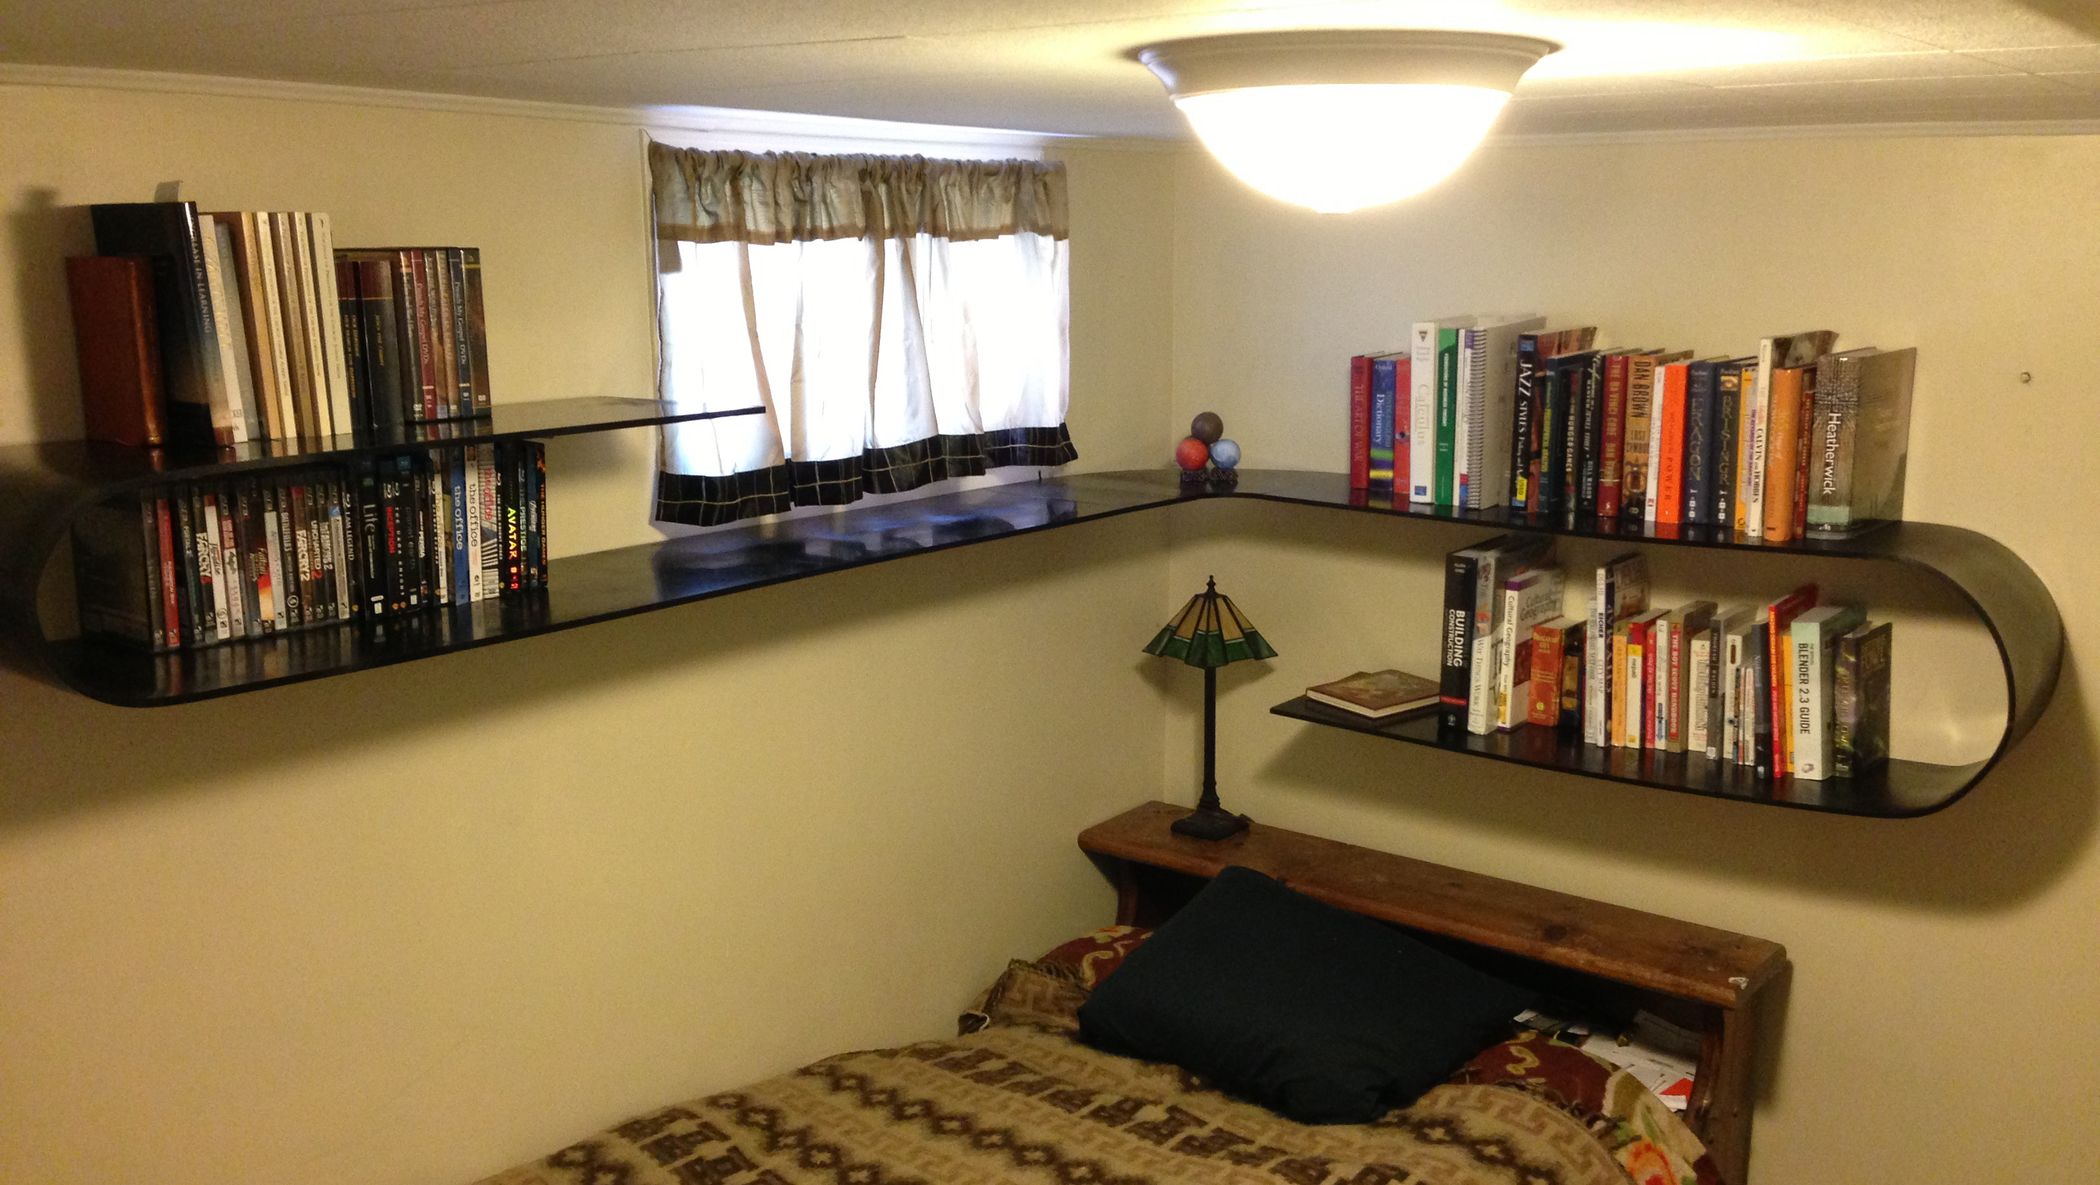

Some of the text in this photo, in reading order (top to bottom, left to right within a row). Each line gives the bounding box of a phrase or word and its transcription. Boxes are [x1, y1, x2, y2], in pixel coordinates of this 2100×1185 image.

[196, 283, 212, 334] LEARNING
[454, 281, 463, 304] Preach
[457, 318, 467, 341] Gospel
[460, 344, 469, 366] DVDs
[1518, 359, 1534, 397] JAZZ
[1631, 361, 1652, 418] DAN BROWN
[1373, 393, 1386, 446] Dictionary
[1517, 400, 1529, 434] STYLES
[1755, 427, 1765, 461] CALVIN
[1821, 412, 1842, 495] Heatherwick
[1752, 470, 1763, 504] HOBBES
[362, 503, 379, 533] Life
[385, 505, 397, 554] INCEPTION
[453, 485, 466, 551] the office
[468, 483, 481, 547] the office
[506, 507, 519, 561] AVATAR
[519, 507, 529, 552] PRESTIGE
[311, 520, 325, 581] UNCHARTED 2
[346, 530, 355, 561] LEGEND
[1506, 595, 1516, 626] Cultural
[1446, 608, 1457, 667] CONSTRUCTION
[1453, 609, 1467, 668] BUILDING
[1502, 627, 1514, 668] Geography
[1670, 634, 1681, 735] THE BOY SCOUT HANDBOOK
[1798, 642, 1811, 735] BLENDER 2.3 GUIDE
